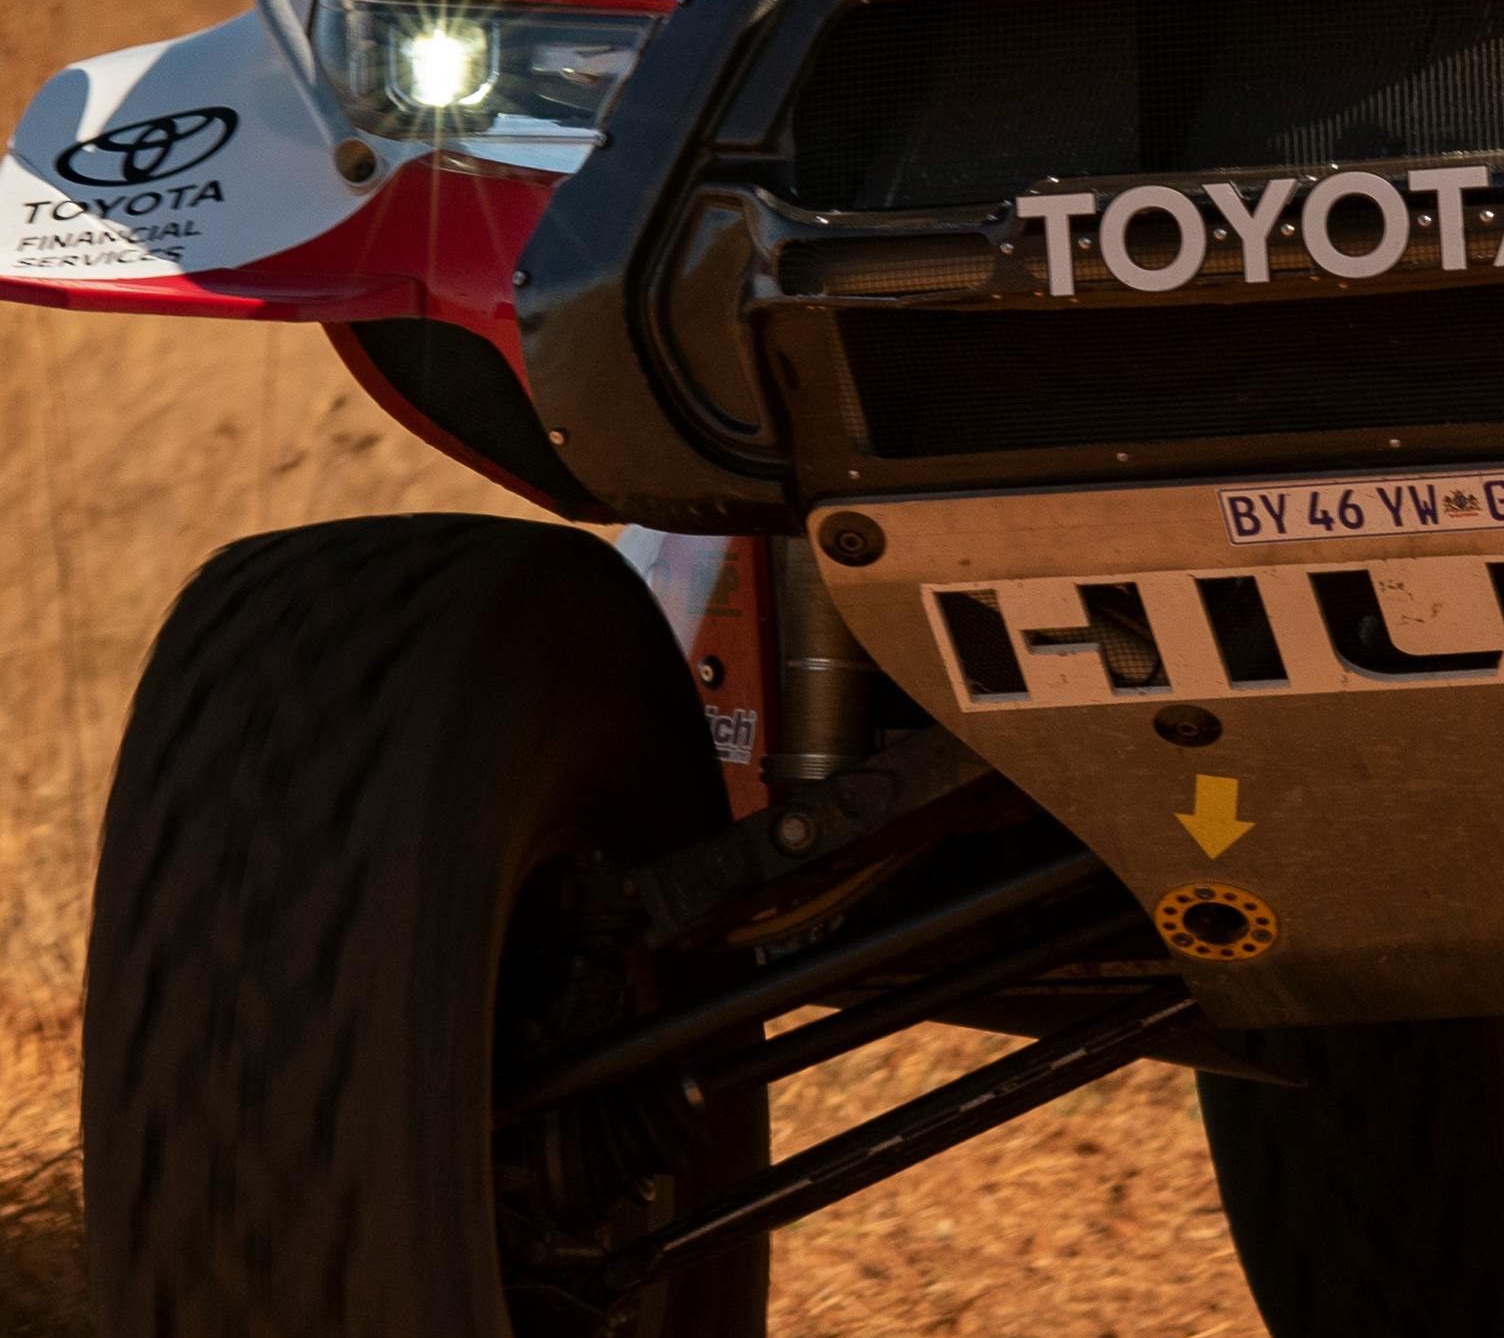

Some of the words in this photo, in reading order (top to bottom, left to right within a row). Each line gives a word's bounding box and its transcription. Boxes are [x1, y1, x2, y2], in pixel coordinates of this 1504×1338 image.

[22, 180, 225, 224] TOYOTA
[15, 219, 203, 253] FINANCIAL
[10, 245, 184, 269] SERVICES
[1227, 493, 1288, 537] BY
[1307, 479, 1366, 532] 46
[1376, 474, 1441, 527] YW
